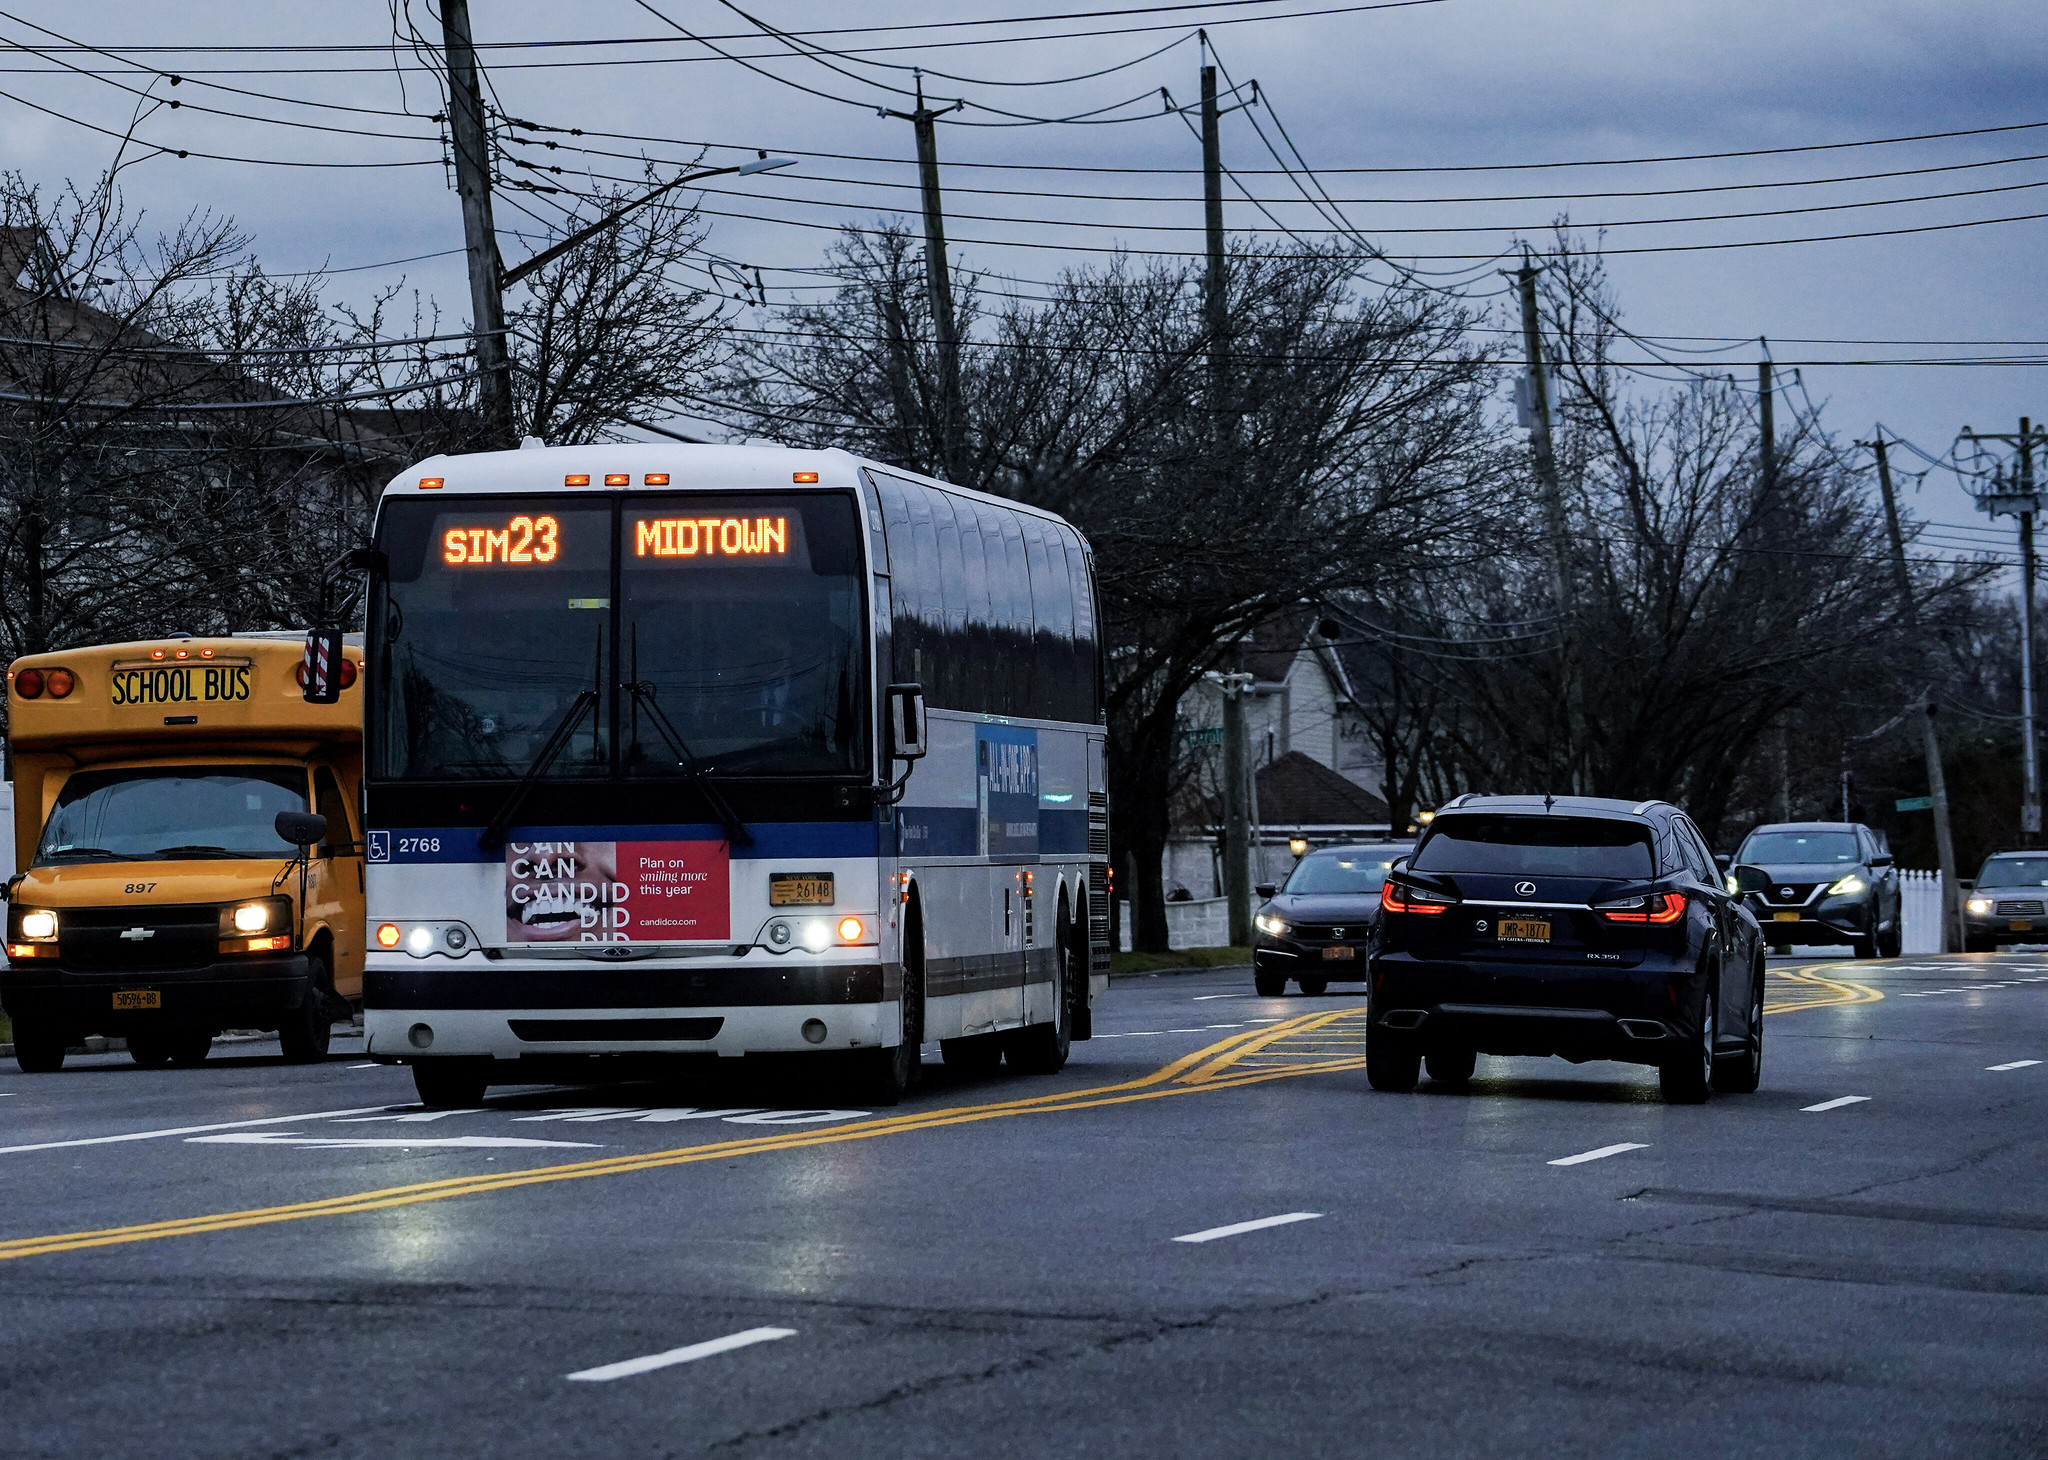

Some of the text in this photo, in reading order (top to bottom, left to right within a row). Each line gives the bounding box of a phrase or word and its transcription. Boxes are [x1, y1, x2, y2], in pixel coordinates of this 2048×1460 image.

[444, 515, 559, 563] SIM23
[636, 517, 786, 557] MIDTOWN
[111, 667, 250, 705] SCHOOL BUS
[399, 837, 441, 853] 2768
[510, 857, 575, 879] CAN
[639, 857, 684, 869] Plan on
[639, 870, 708, 884] smiling more
[124, 882, 158, 894] 897
[510, 882, 631, 904] CANDID
[639, 884, 693, 898] this year
[580, 907, 631, 929] DID
[639, 918, 698, 927] candidco.com
